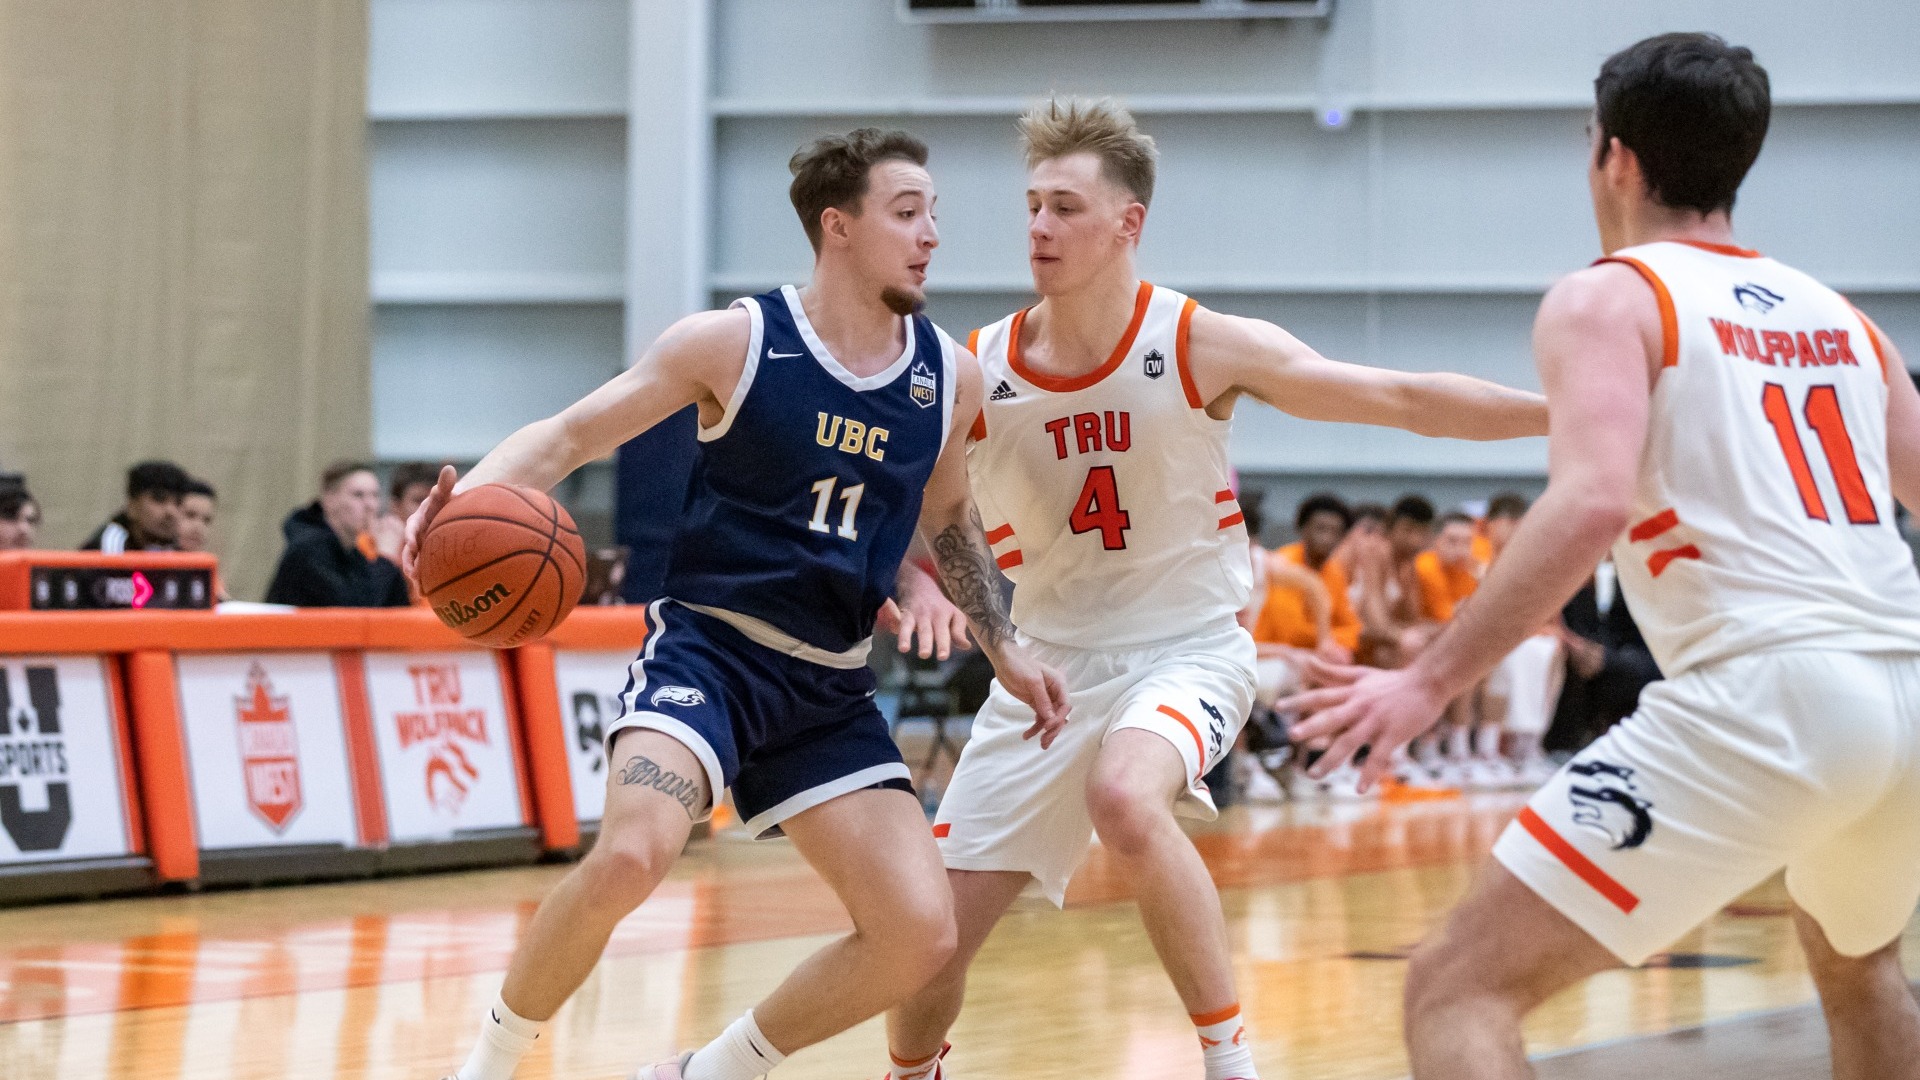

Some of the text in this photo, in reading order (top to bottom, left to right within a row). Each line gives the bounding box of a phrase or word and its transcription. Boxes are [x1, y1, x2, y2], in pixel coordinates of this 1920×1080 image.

[1146, 360, 1162, 373] CW
[1708, 316, 1859, 367] WOLFPACK
[913, 386, 934, 402] WEST
[989, 391, 1017, 401] adidas
[815, 411, 890, 462] UBC
[1045, 411, 1131, 460] TRU
[1761, 381, 1881, 526] 11
[808, 476, 865, 542] 11
[1069, 465, 1131, 550] 4
[407, 665, 461, 704] TRU
